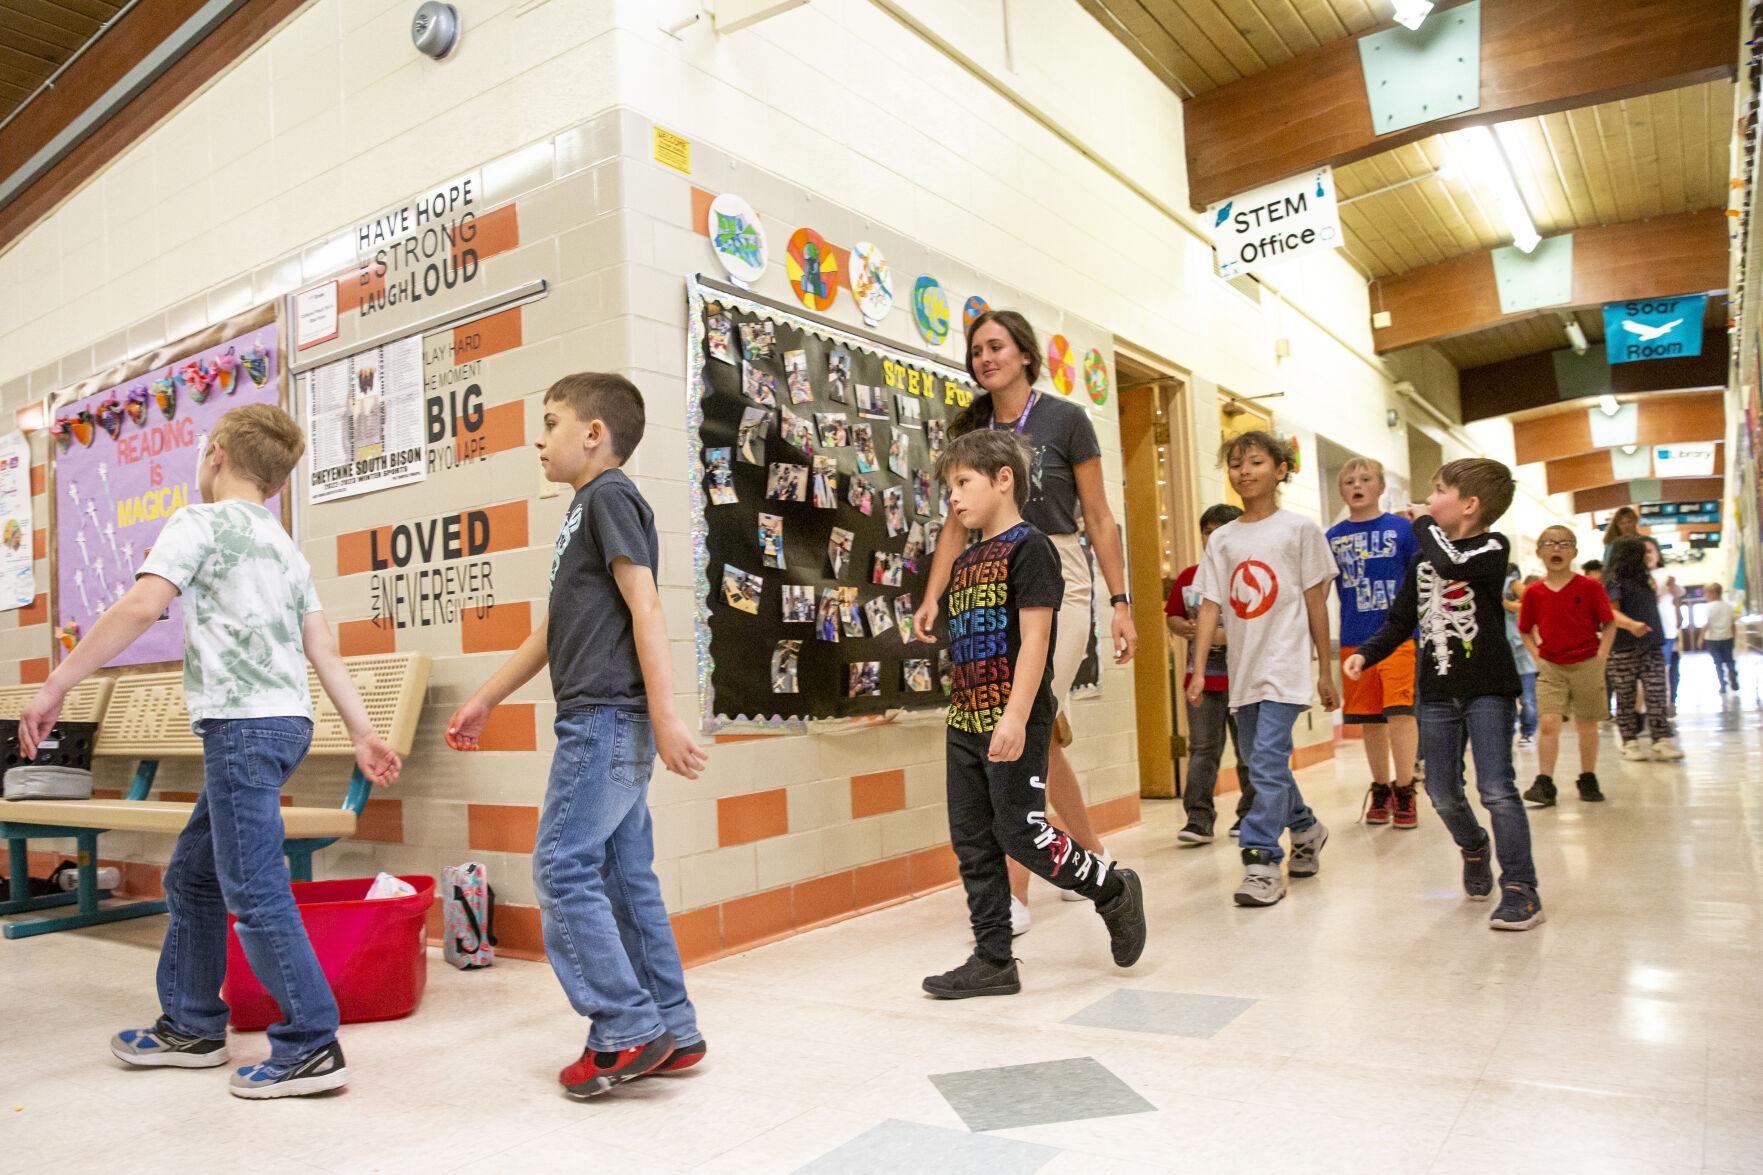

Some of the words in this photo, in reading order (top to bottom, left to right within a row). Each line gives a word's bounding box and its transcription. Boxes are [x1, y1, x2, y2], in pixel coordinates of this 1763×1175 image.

[360, 207, 409, 250] HAVE
[416, 179, 473, 226] HOPE
[1234, 192, 1307, 234] STEM
[375, 211, 477, 279] STRONG
[1240, 228, 1315, 263] Office
[360, 280, 409, 318] LAUGH
[411, 248, 479, 303] LOUD
[1625, 301, 1681, 317] Soar
[423, 344, 447, 365] LAY
[449, 333, 481, 357] HARD
[1626, 342, 1683, 360] Room
[438, 360, 482, 387] MOMENT
[883, 360, 935, 399] STEM
[427, 383, 484, 444] BIG
[117, 416, 194, 466] READING
[312, 462, 354, 487] CHEYENNE
[355, 454, 388, 476] SOUTH
[390, 446, 422, 468] BISON
[370, 510, 490, 572] LOVED
[382, 568, 446, 631] NEVER
[445, 561, 494, 596] EVER
[446, 595, 474, 624] GIV
[476, 593, 495, 620] UP
